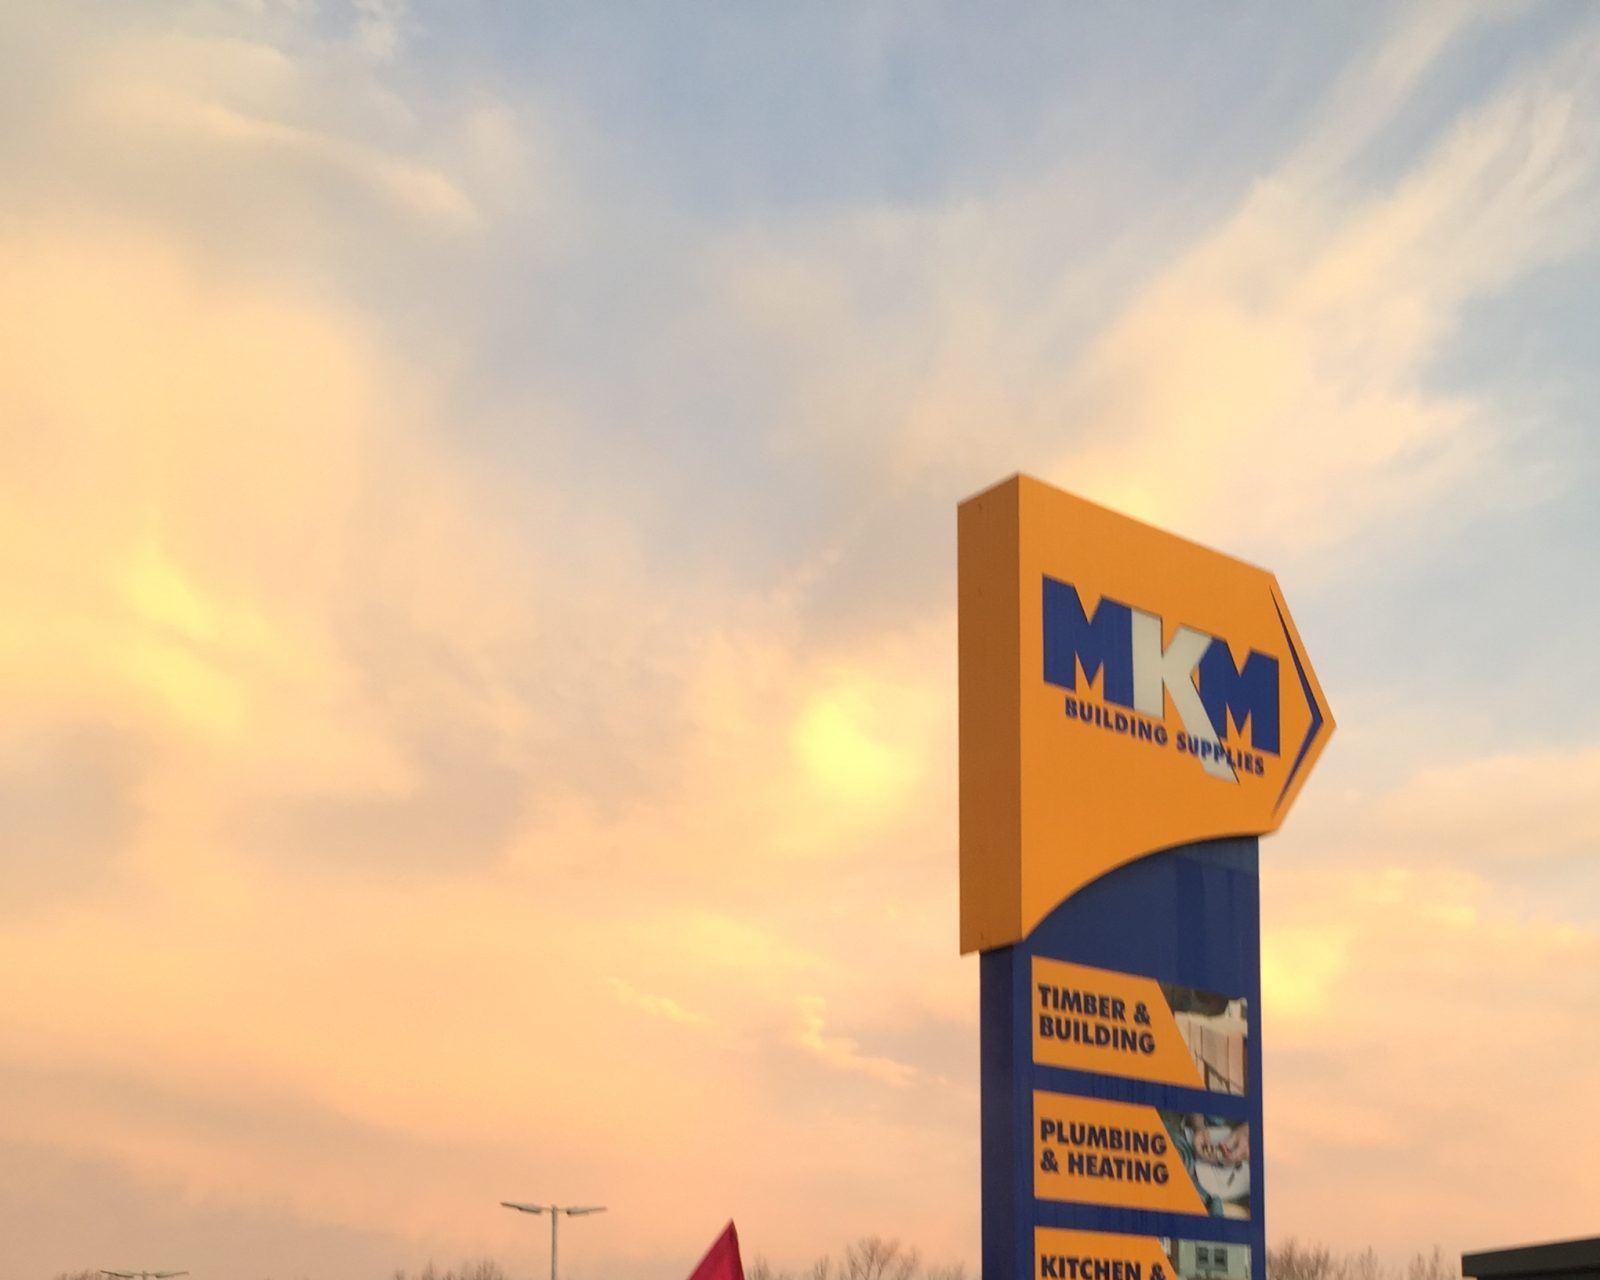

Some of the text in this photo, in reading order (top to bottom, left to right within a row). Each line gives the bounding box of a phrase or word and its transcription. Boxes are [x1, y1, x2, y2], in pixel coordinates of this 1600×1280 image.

[1041, 573, 1281, 785] MKM
[1064, 696, 1265, 776] BUILDING SUPPLIES
[1038, 984, 1151, 1026] TIMBER &
[1039, 1014, 1155, 1055] BUILDING
[1040, 1118, 1167, 1155] PLUMBING
[1040, 1149, 1169, 1185] & HEATING
